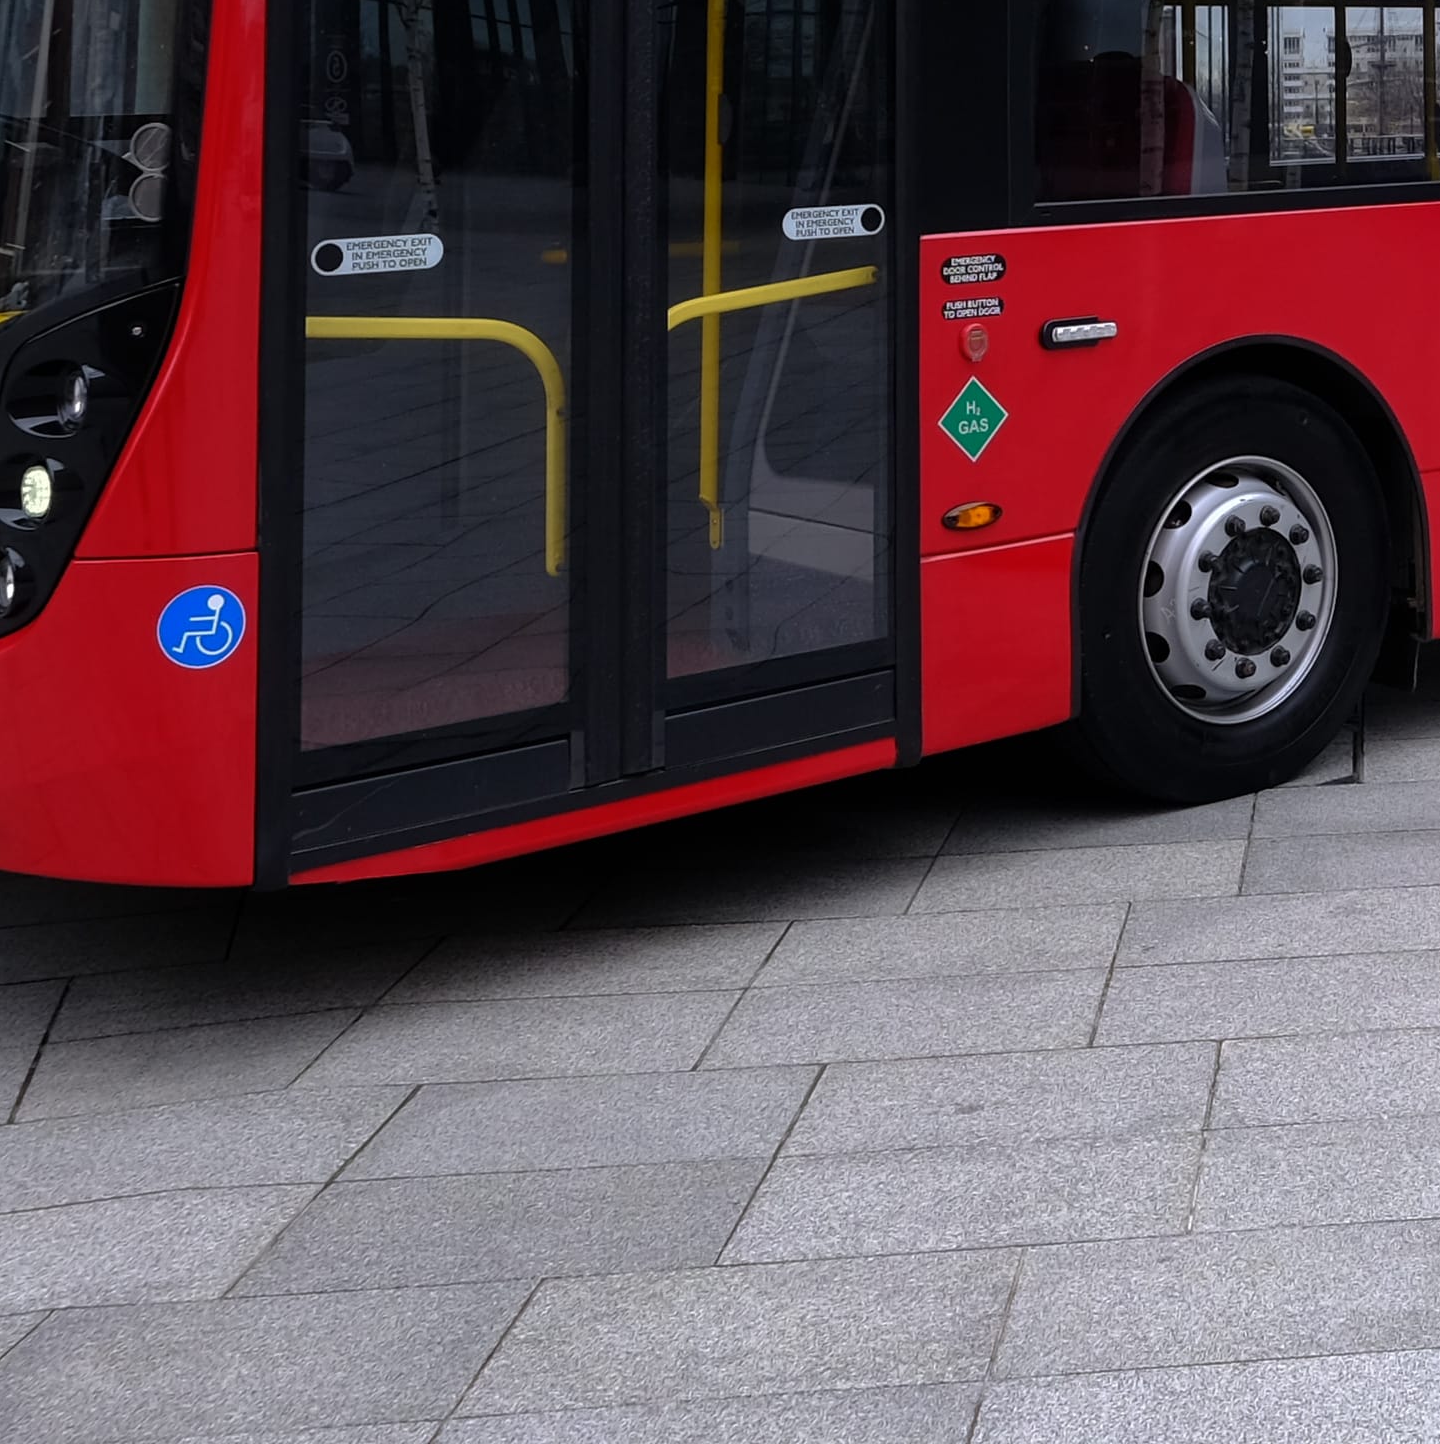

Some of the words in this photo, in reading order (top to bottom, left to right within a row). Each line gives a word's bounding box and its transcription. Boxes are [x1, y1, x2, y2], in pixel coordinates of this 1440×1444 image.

[806, 218, 855, 228] EMERGENCY
[819, 227, 831, 236] TO
[347, 238, 408, 251] EMERGENCY
[411, 237, 433, 247] EXIT
[352, 251, 362, 260] IN
[365, 247, 427, 260] EMERGENCY
[352, 260, 379, 271] PUSH
[382, 259, 397, 269] TO
[399, 257, 427, 267] OPEN
[942, 266, 966, 276] DOOR
[967, 263, 1005, 273] CONTROL
[943, 310, 955, 319] TO
[957, 308, 977, 318] OPEN
[978, 306, 1002, 316] DOOR
[958, 417, 989, 435] GAS
